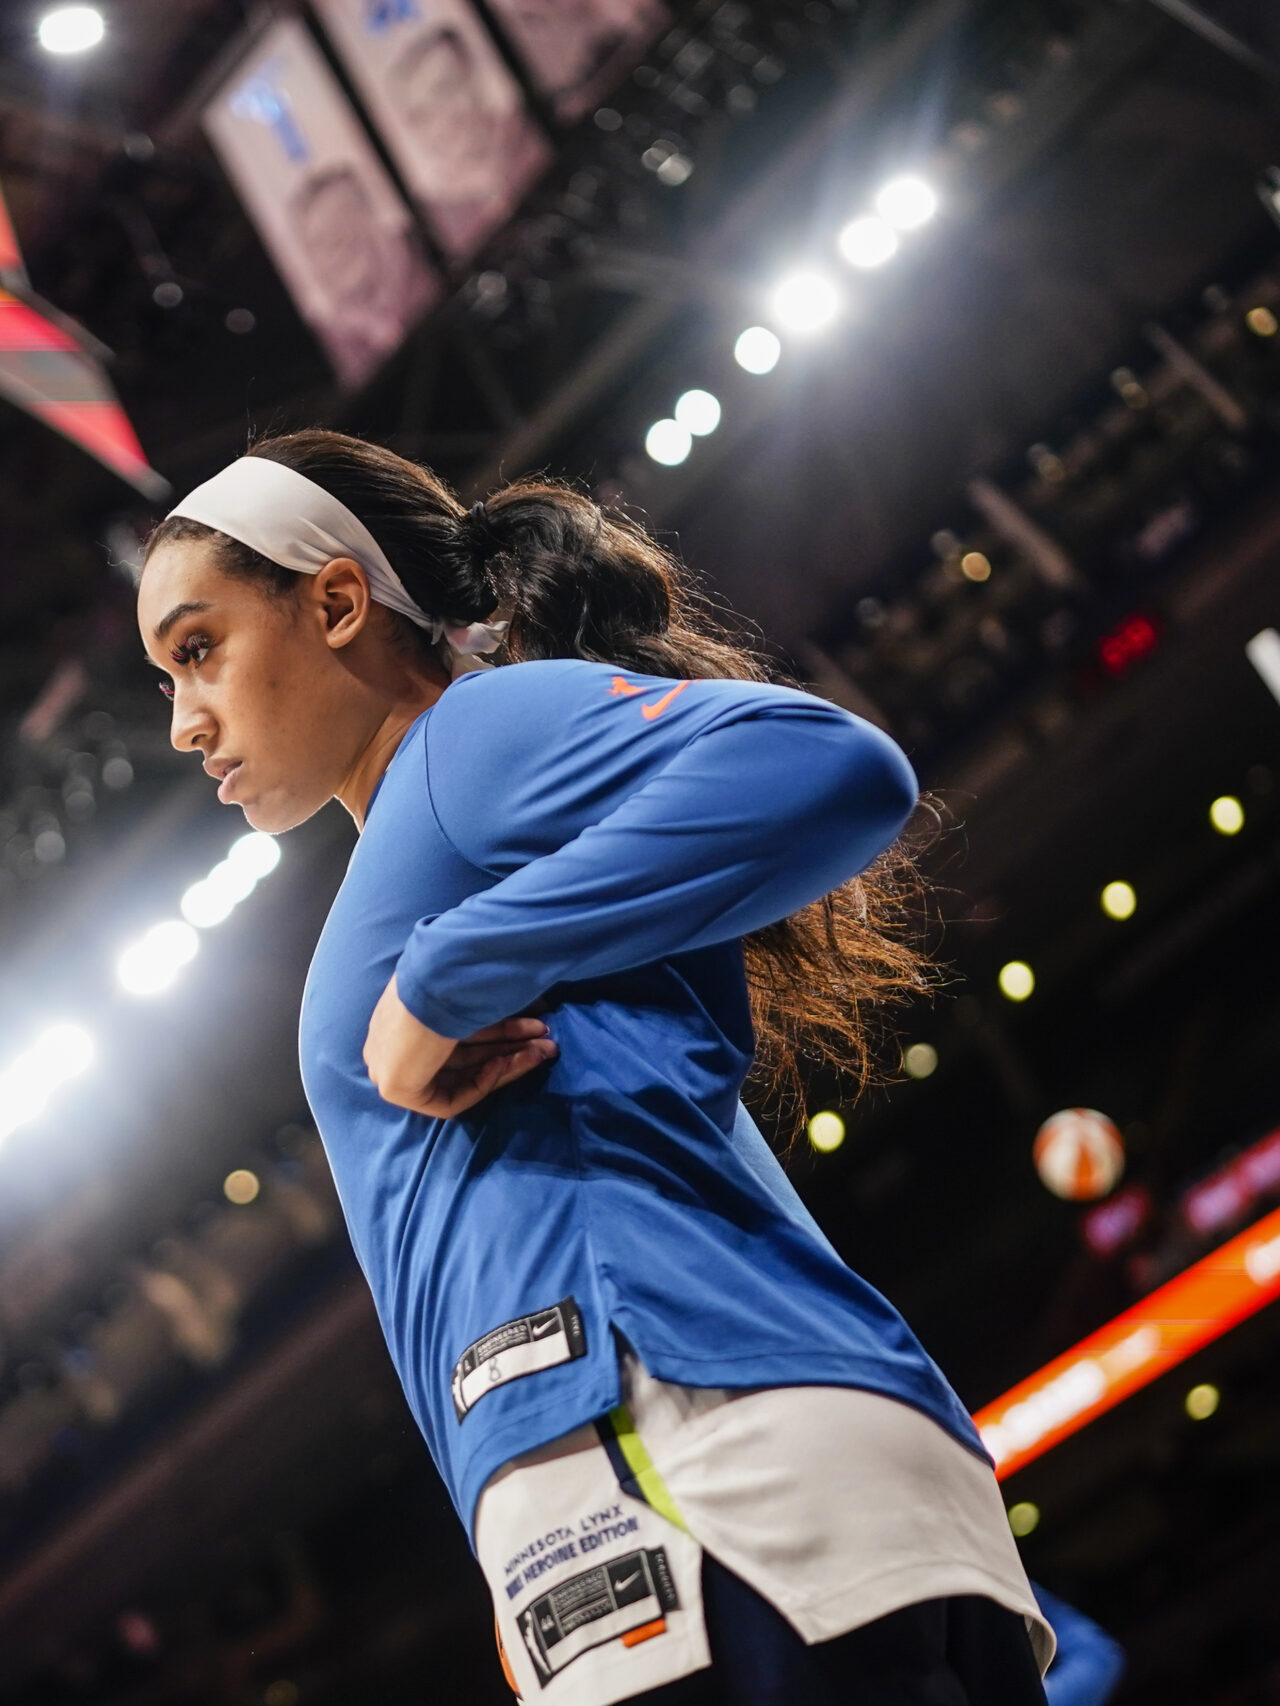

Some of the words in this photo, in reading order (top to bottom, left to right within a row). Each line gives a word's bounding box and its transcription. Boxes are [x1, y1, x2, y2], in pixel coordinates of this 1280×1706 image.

[504, 1526, 575, 1576] MINNESOTA
[579, 1504, 624, 1531] LYNX
[522, 1541, 579, 1584] HEROINE
[579, 1515, 639, 1553] EDITION
